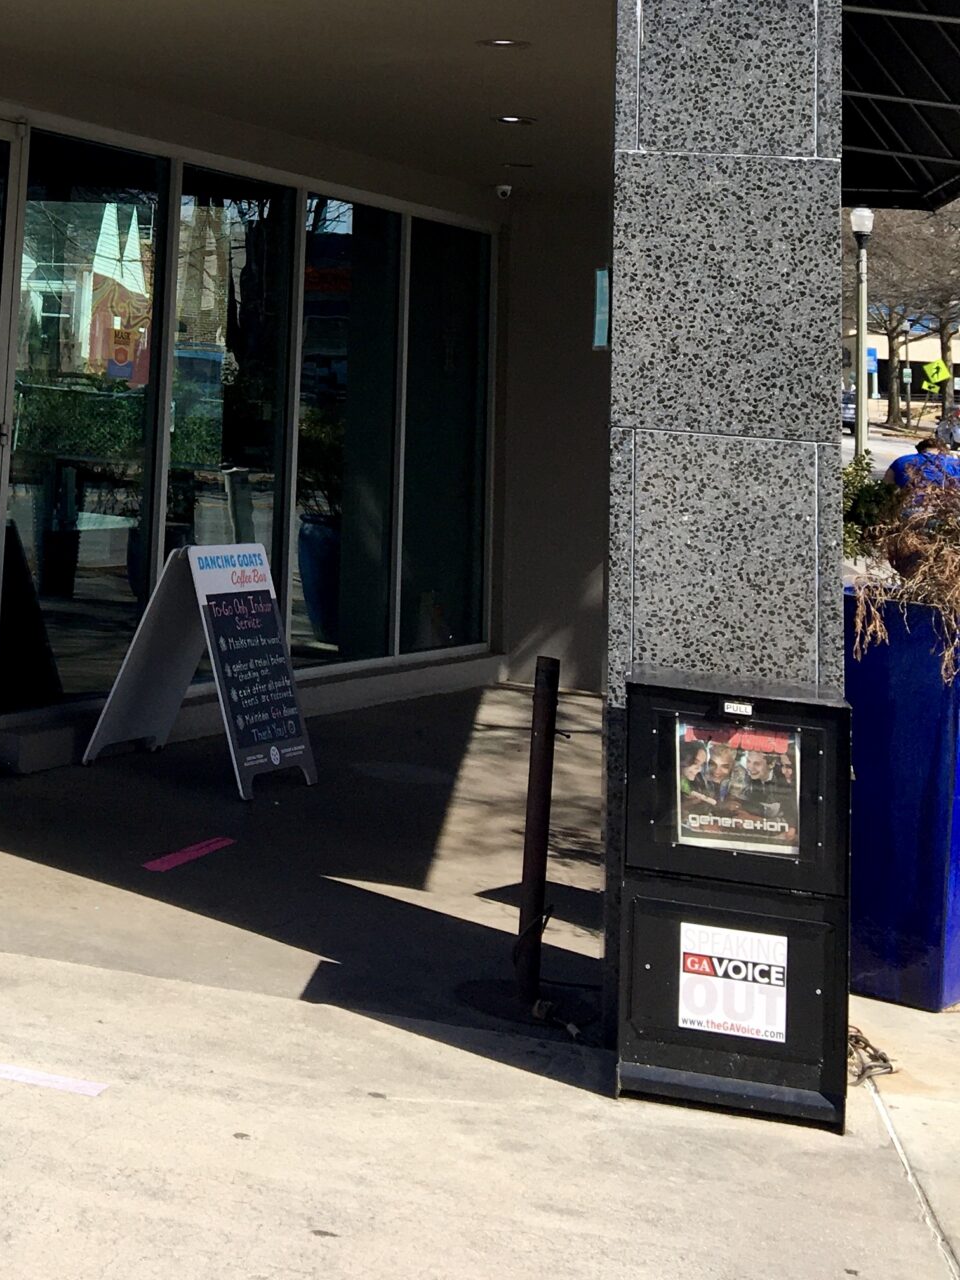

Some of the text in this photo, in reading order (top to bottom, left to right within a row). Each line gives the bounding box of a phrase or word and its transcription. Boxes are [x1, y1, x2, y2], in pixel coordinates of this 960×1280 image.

[197, 553, 263, 570] DANCING GOATS
[231, 568, 267, 588] Coffee Bar
[234, 598, 249, 618] Only
[726, 704, 751, 714] PULL
[688, 813, 789, 832] generation
[684, 927, 786, 964] SPEAKING
[682, 975, 785, 1027] OUT
[681, 1016, 785, 1040] www.theGAVoice.com
